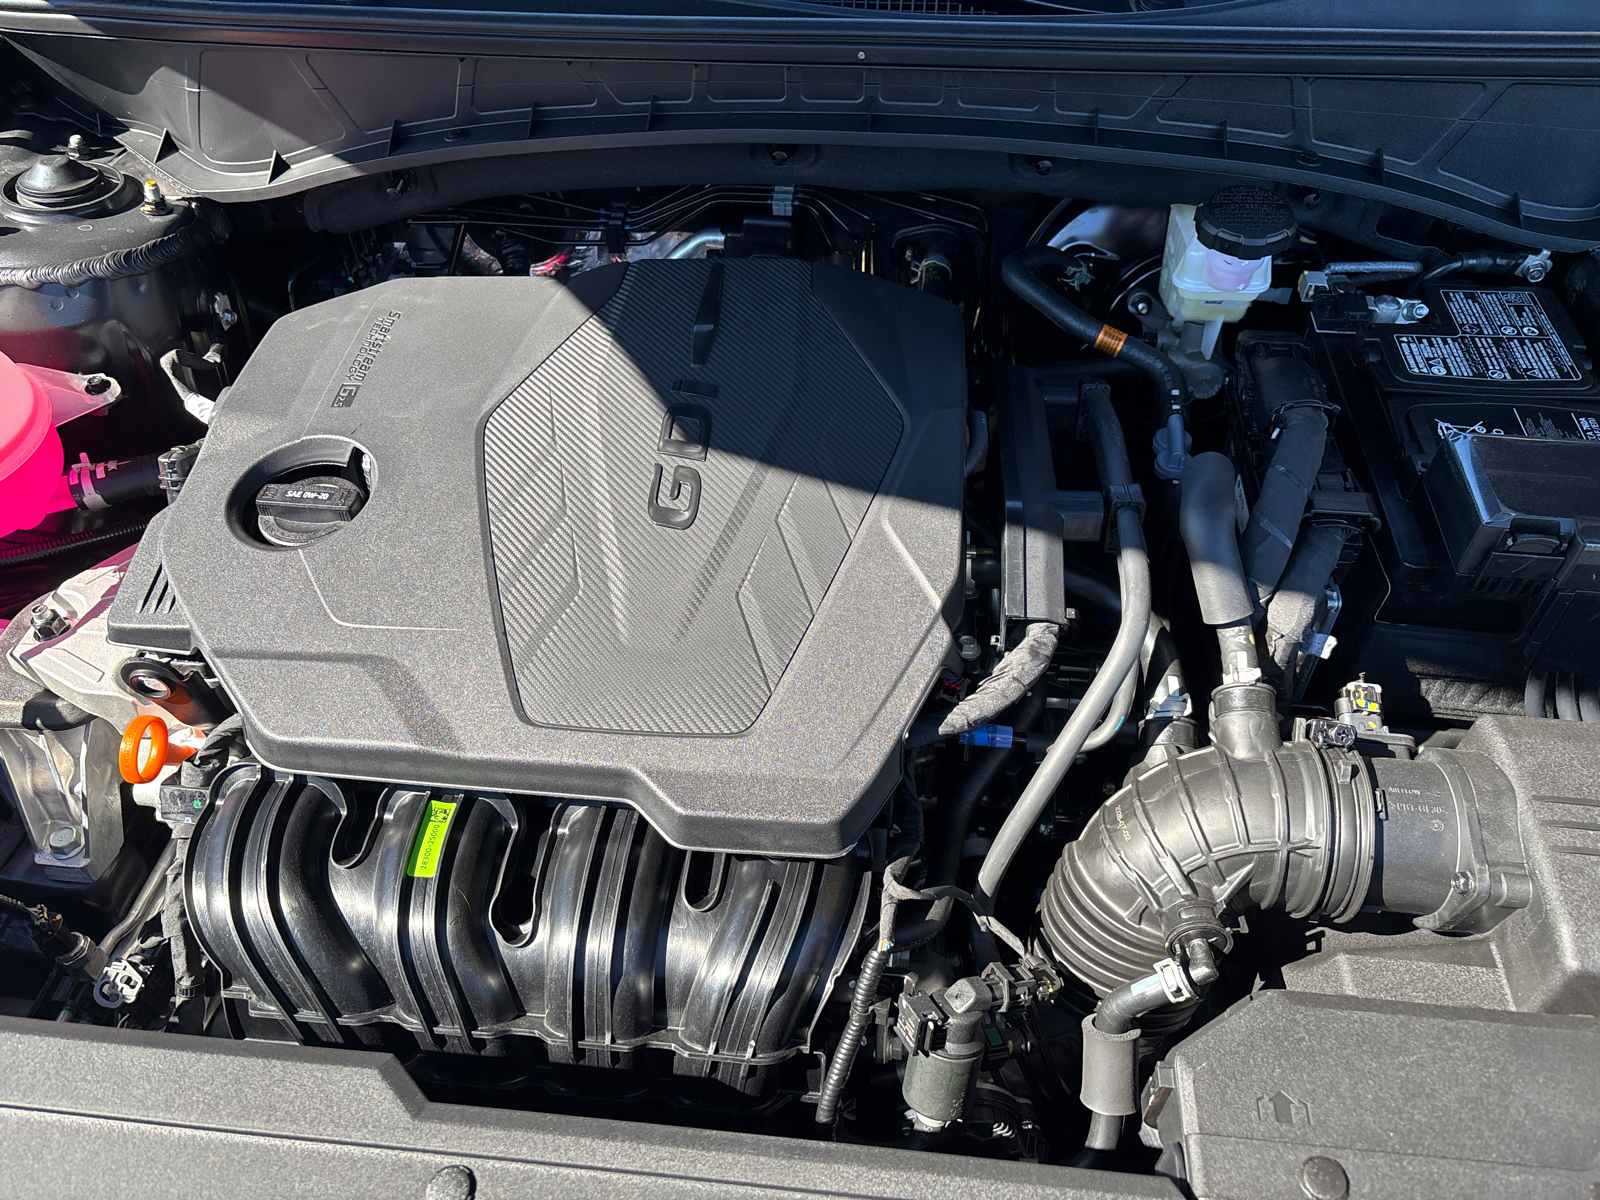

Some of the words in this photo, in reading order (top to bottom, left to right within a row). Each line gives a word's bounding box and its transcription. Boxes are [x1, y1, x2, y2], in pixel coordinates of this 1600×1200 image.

[354, 309, 402, 382] Smartstream
[647, 378, 719, 531] GDI
[286, 490, 302, 498] SAE
[302, 491, 330, 500] 0W-20
